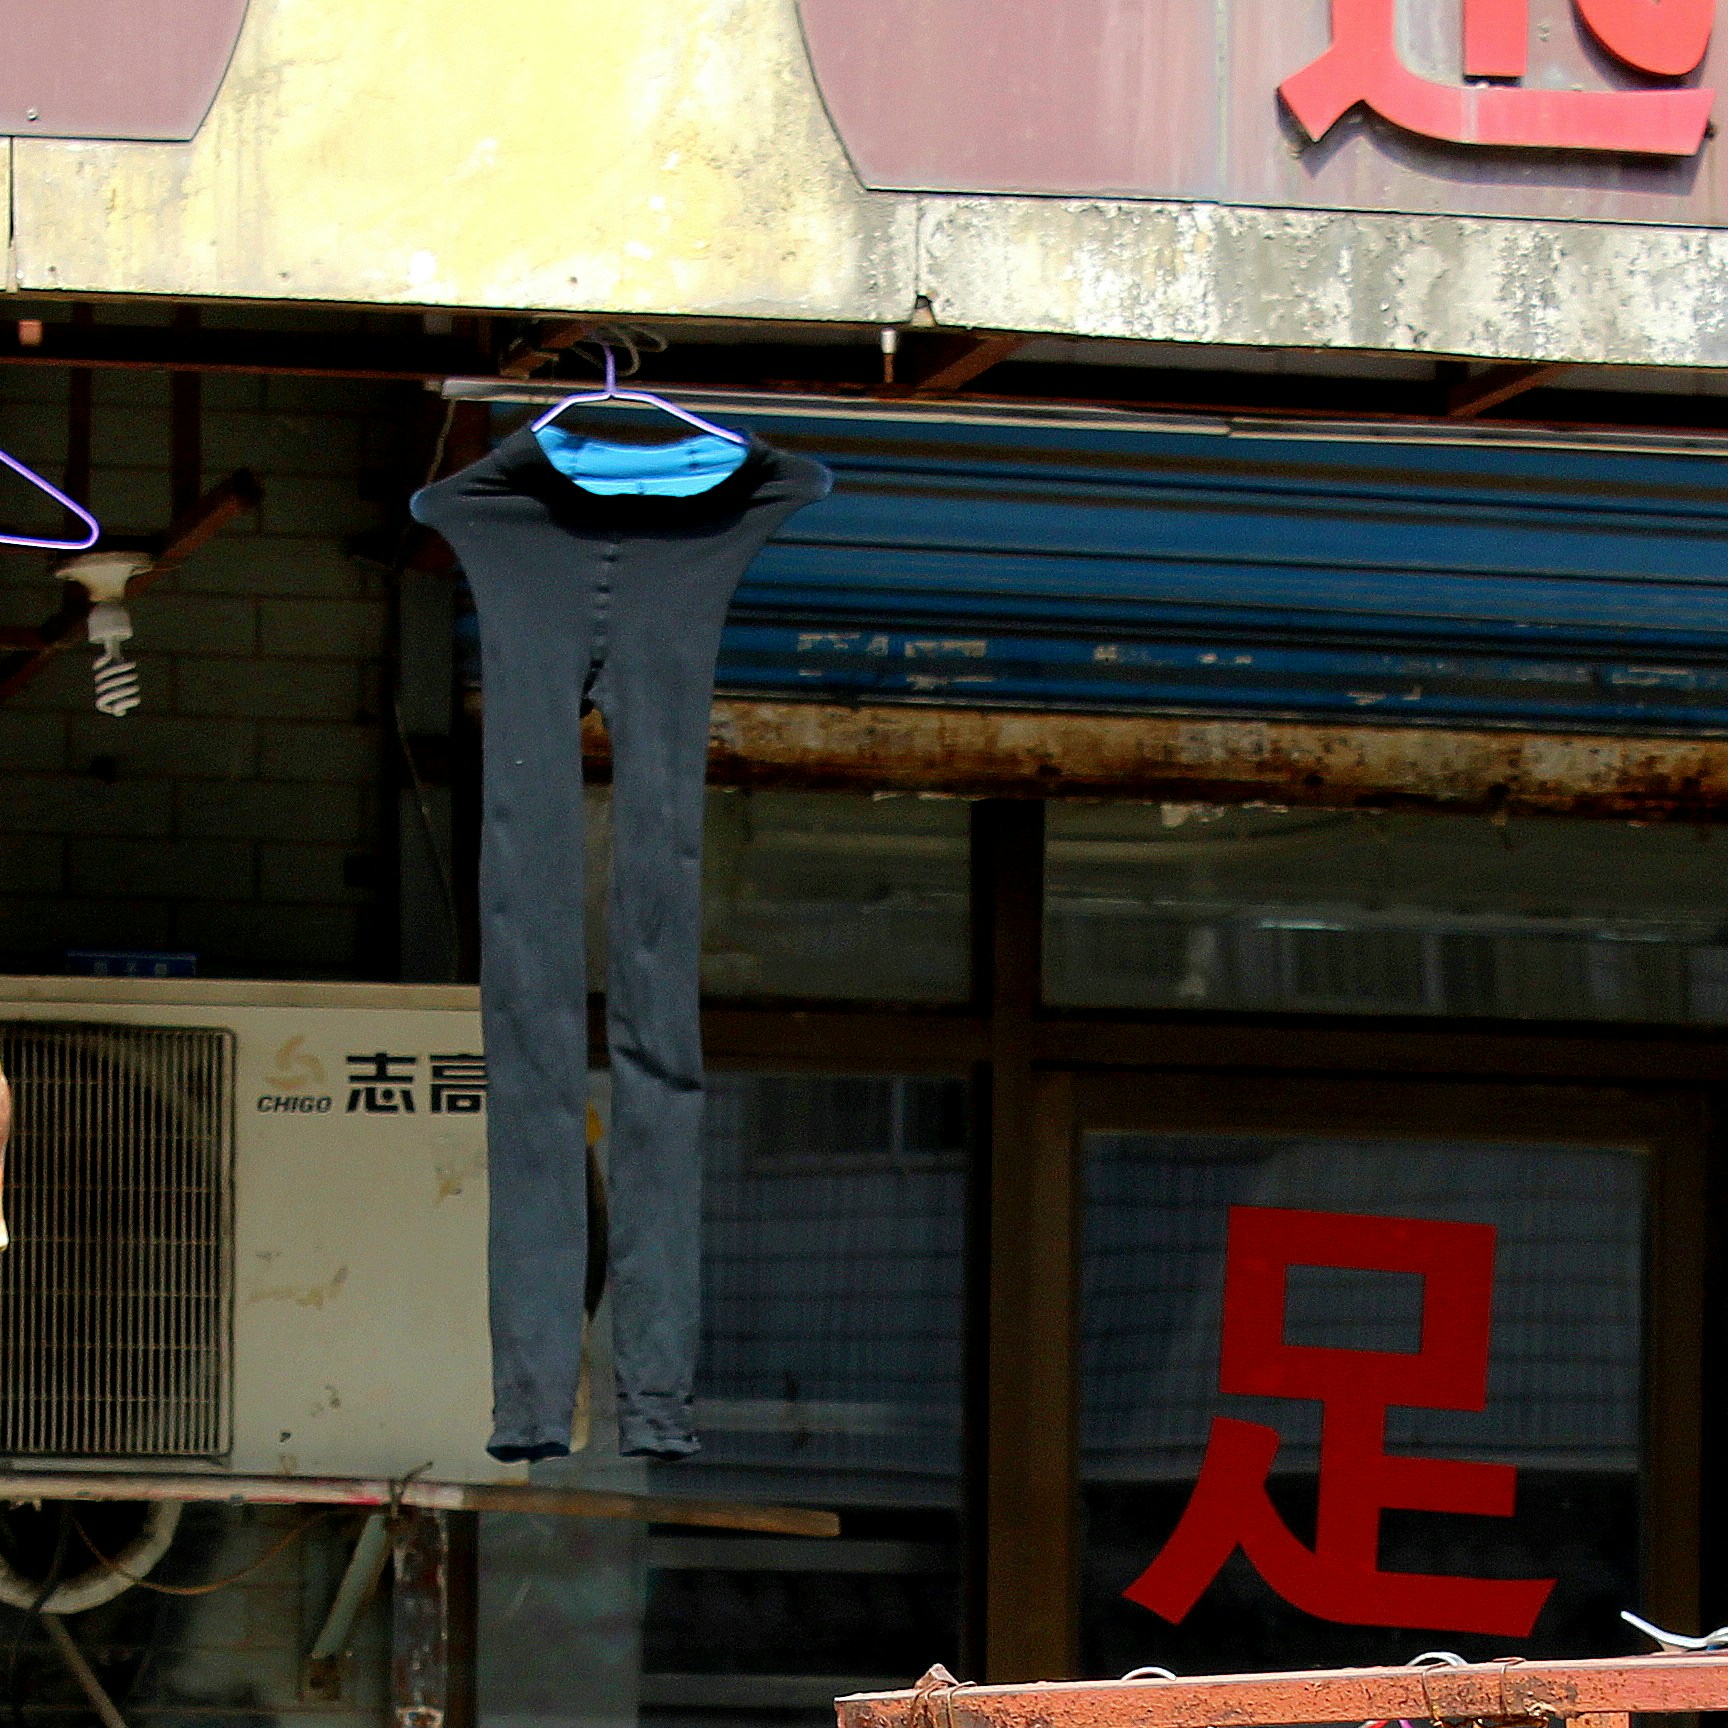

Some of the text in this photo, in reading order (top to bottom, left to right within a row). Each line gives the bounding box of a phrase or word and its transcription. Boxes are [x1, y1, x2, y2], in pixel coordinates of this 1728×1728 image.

[256, 1095, 333, 1114] CHIGO
[345, 1053, 488, 1114] 志高
[1120, 1204, 1558, 1638] 足
